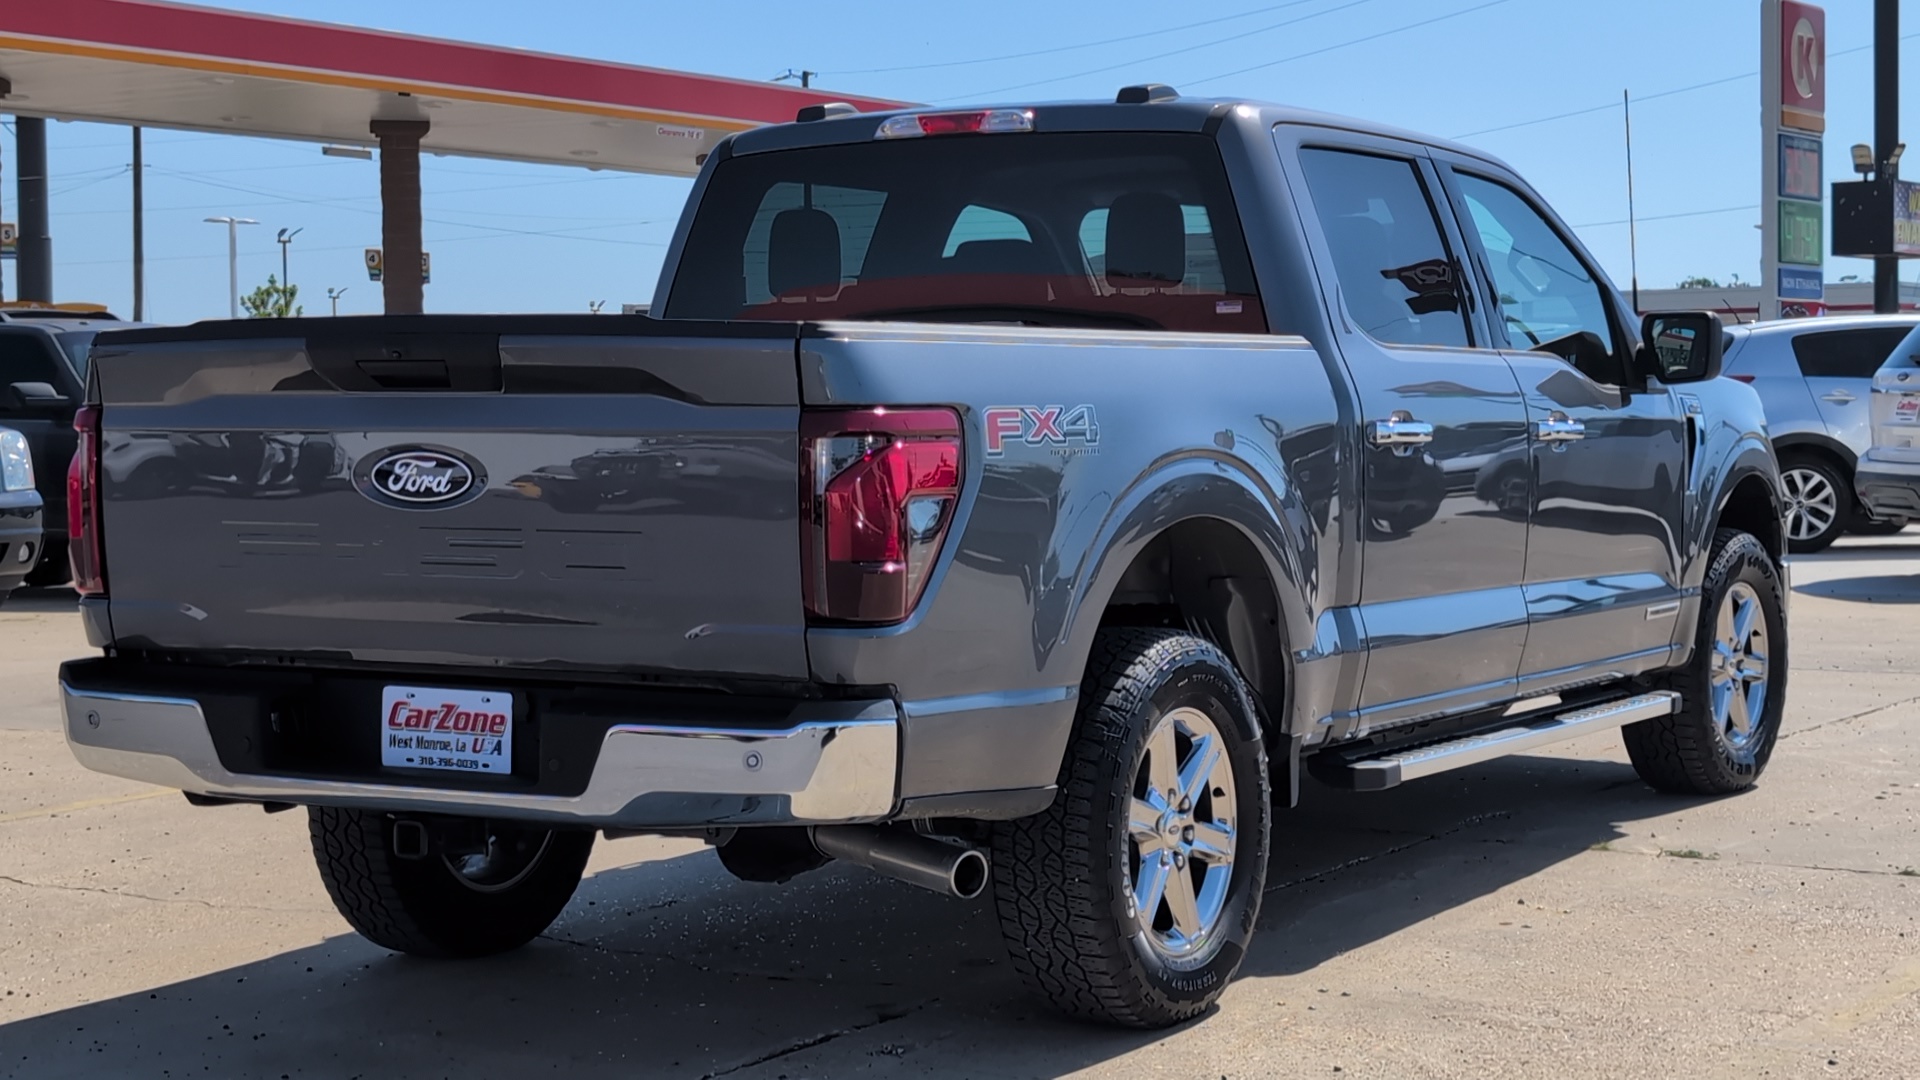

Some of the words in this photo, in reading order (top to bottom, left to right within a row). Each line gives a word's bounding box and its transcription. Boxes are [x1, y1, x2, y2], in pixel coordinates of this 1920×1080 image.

[1797, 34, 1816, 83] K
[4, 229, 11, 240] 5
[369, 254, 376, 263] 4
[982, 404, 1100, 459] FX4
[388, 459, 453, 493] Ford
[388, 701, 508, 736] CarZone
[389, 734, 413, 749] West
[456, 738, 467, 752] La
